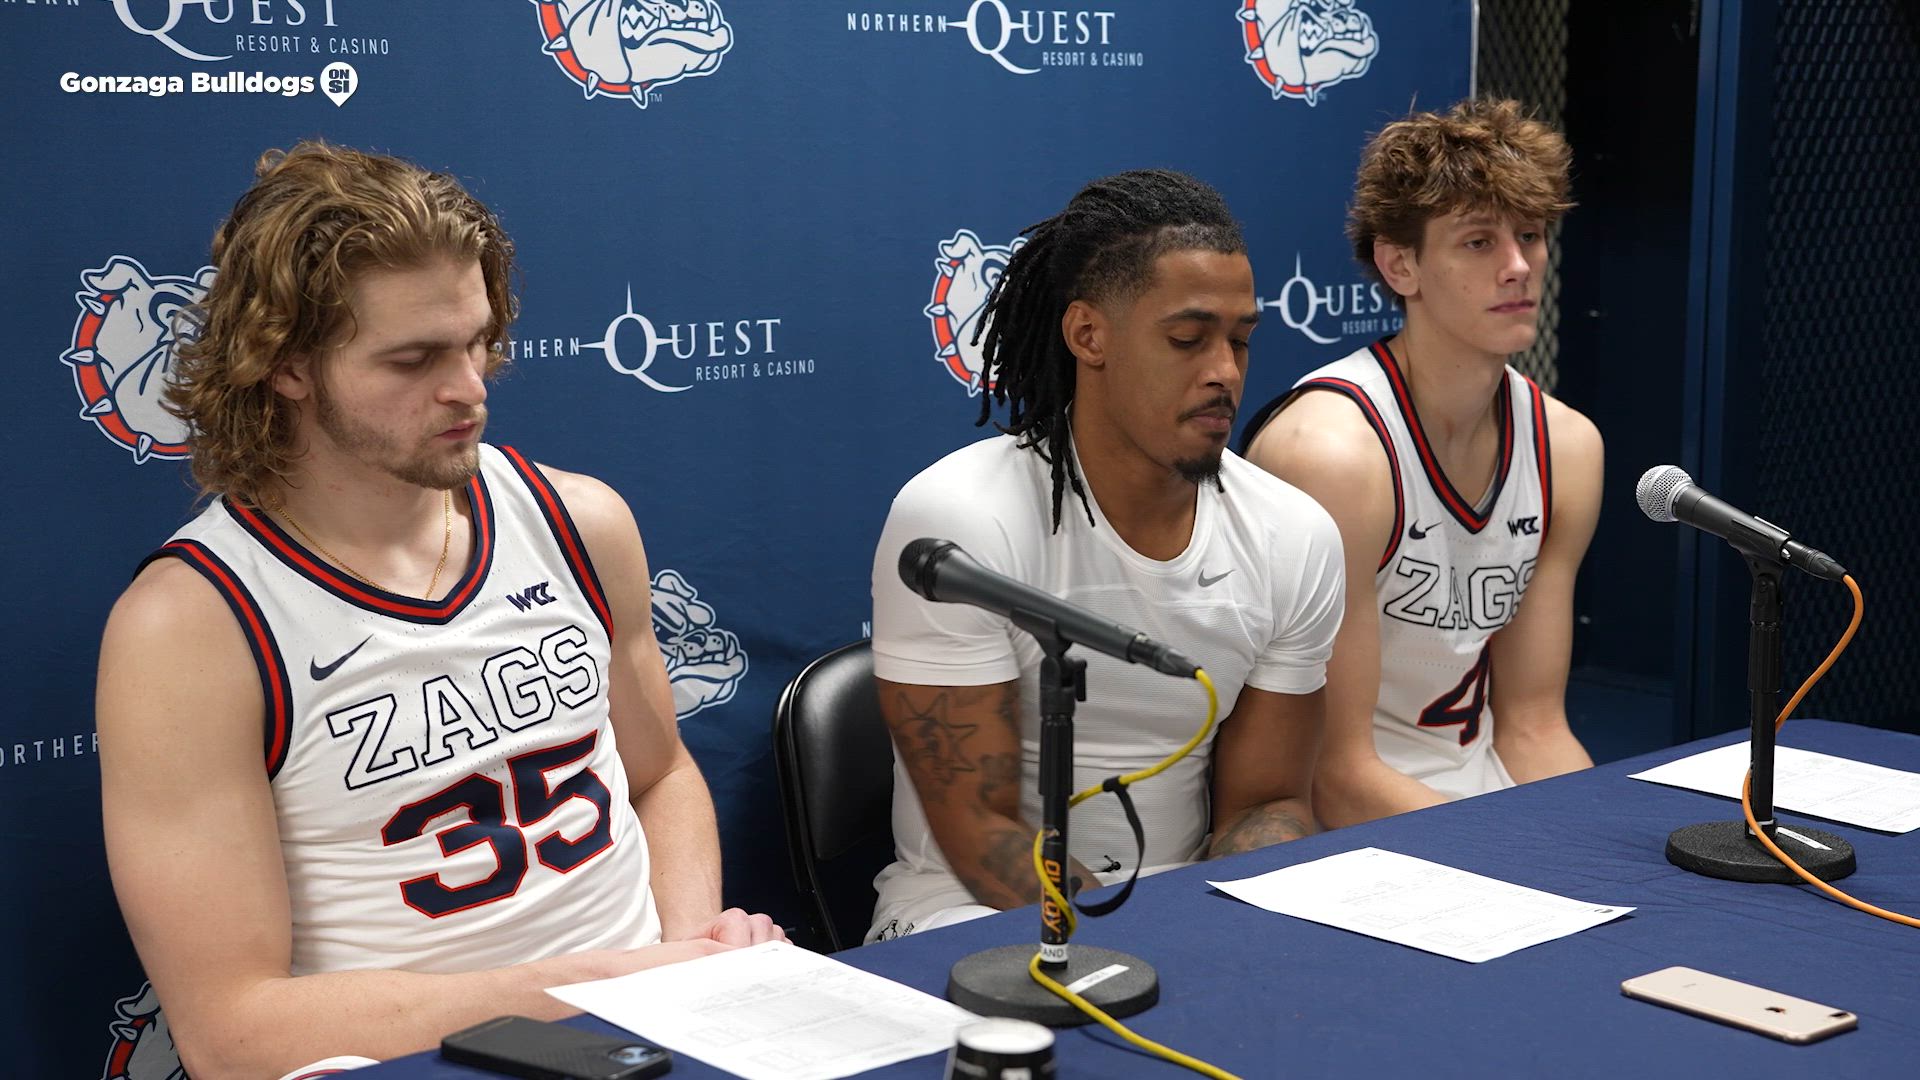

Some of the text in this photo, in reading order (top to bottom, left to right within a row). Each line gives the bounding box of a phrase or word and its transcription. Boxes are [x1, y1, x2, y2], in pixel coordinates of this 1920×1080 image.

[236, 34, 389, 55] RESORT & CASINO
[847, 0, 1115, 75] NORTHERN QUEST
[1042, 52, 1144, 67] RESORT & CASINO
[1279, 275, 1400, 345] QUES
[494, 312, 781, 393] THERN QUEST
[696, 358, 816, 382] RESORT & CASINO
[505, 581, 558, 613] WCC
[325, 624, 601, 791] ZAGS
[1416, 634, 1492, 748] 4
[380, 729, 614, 919] 35
